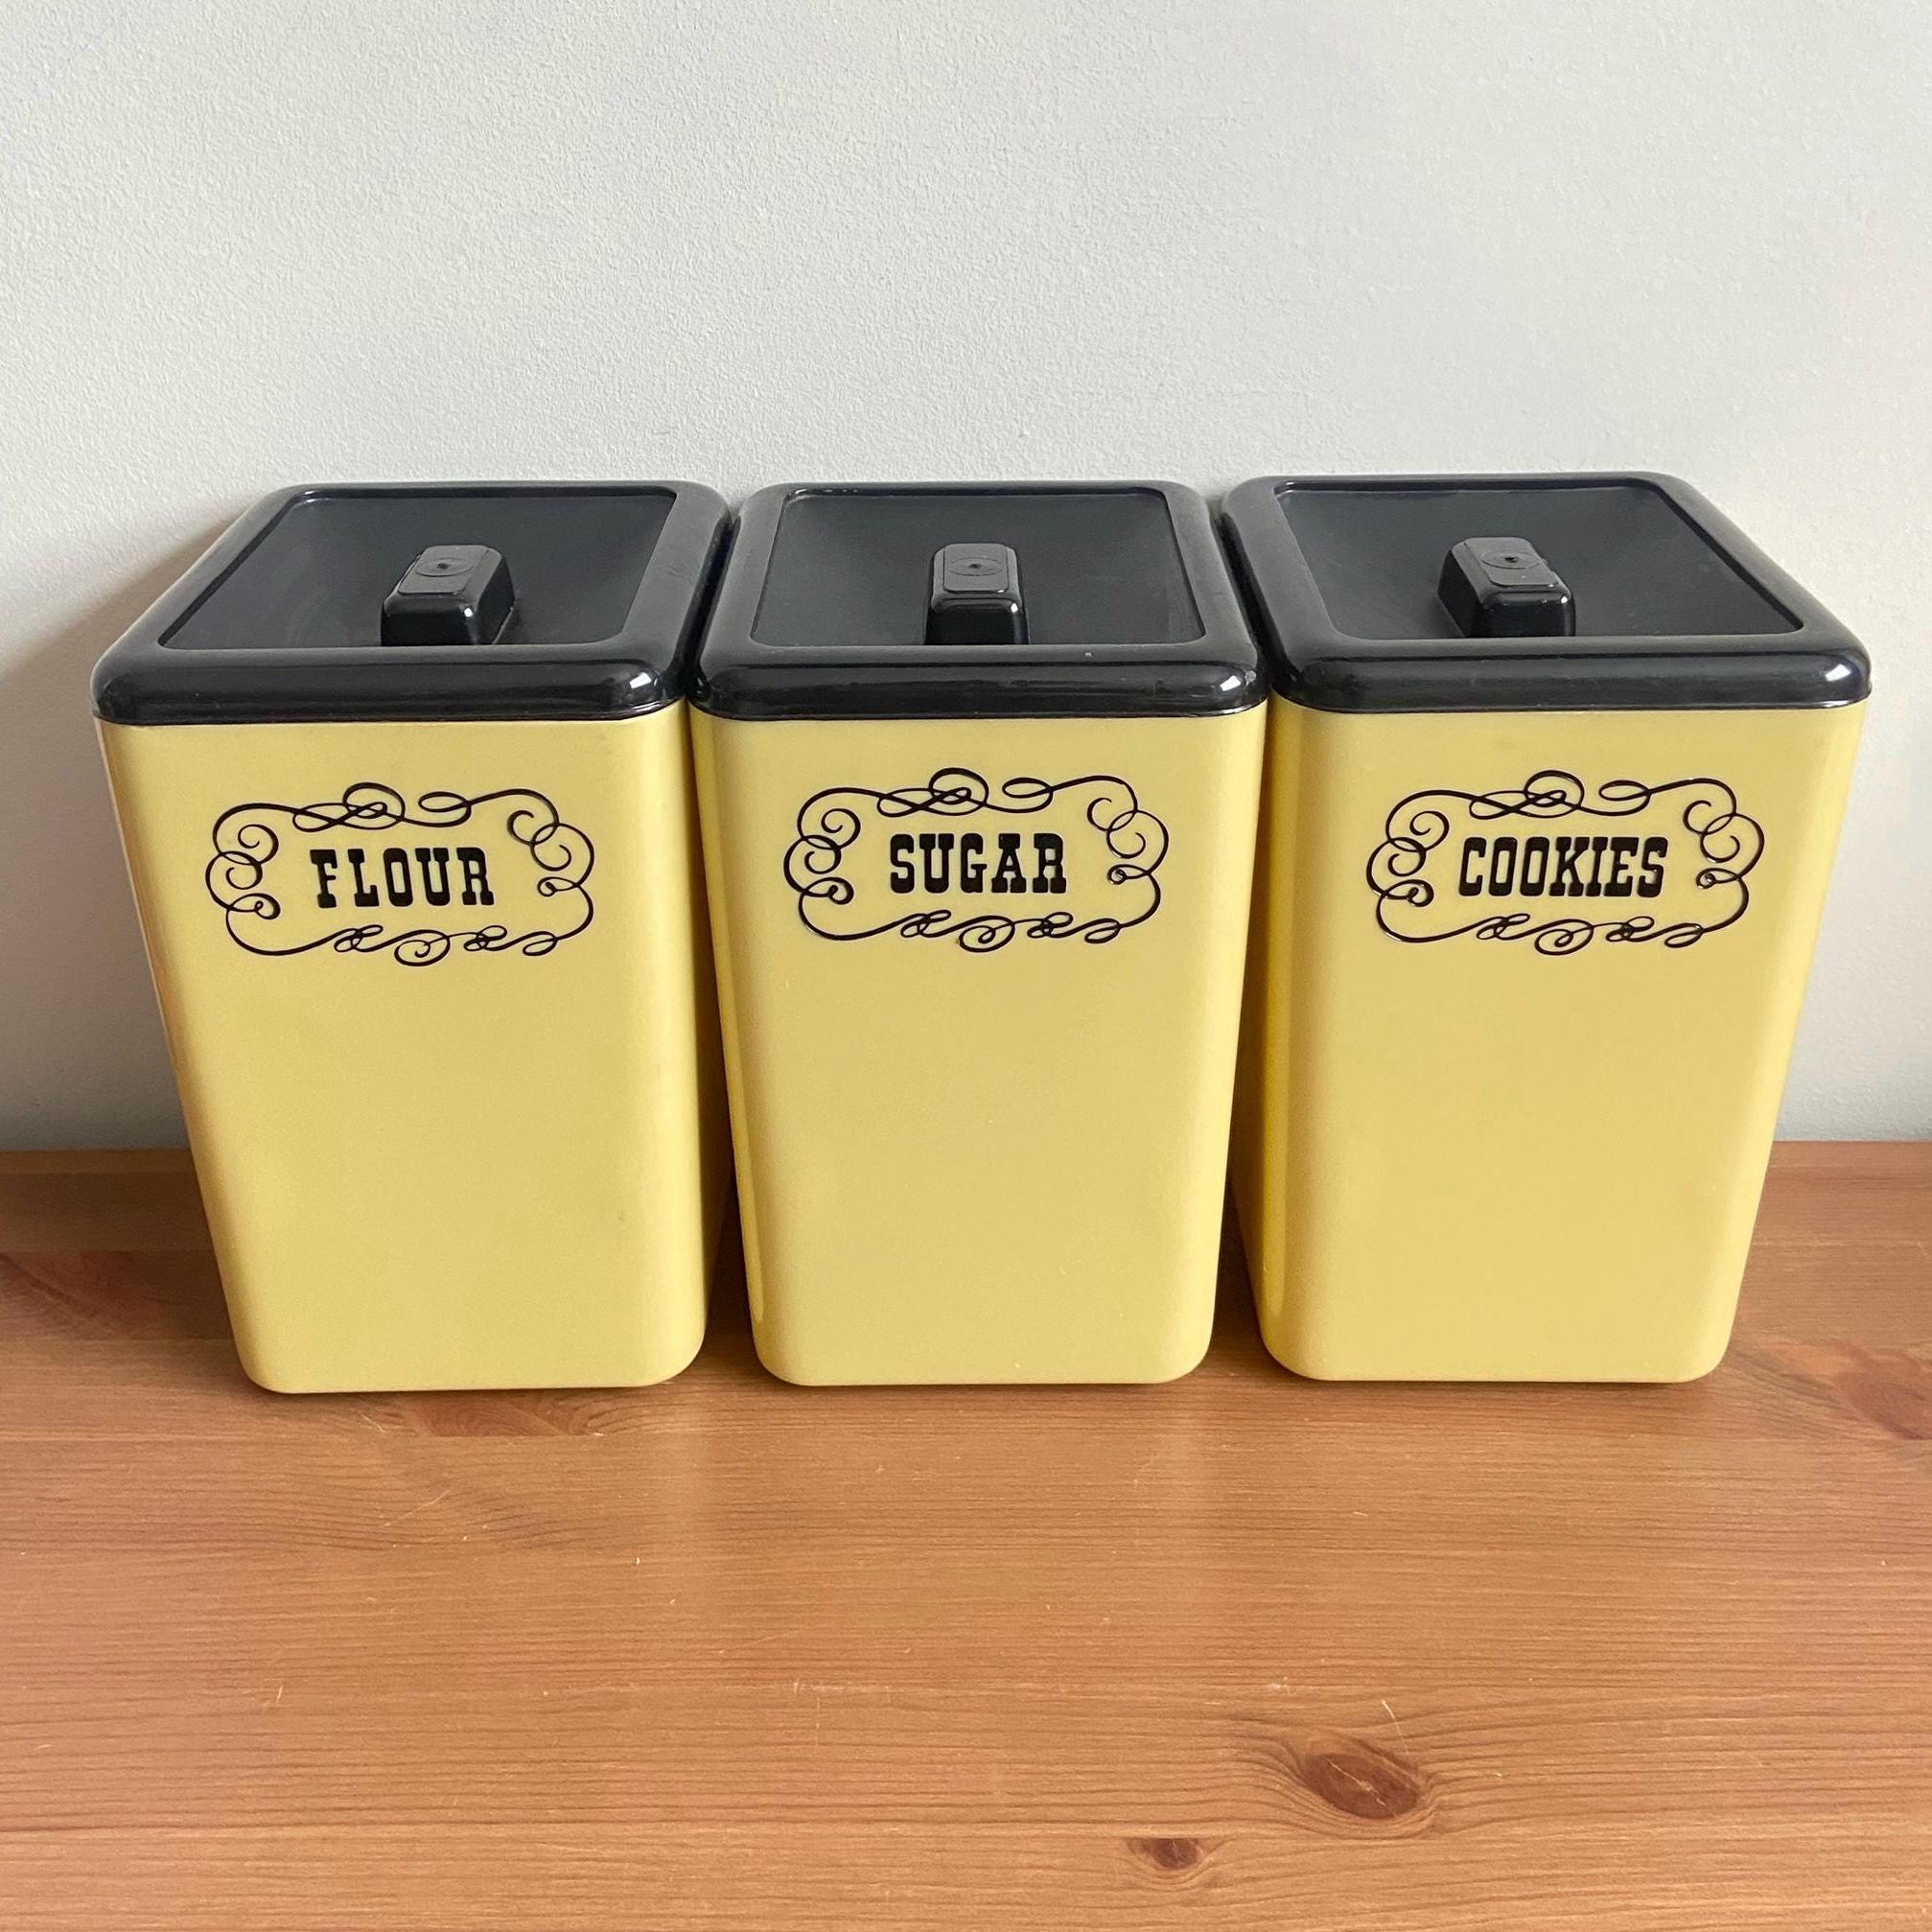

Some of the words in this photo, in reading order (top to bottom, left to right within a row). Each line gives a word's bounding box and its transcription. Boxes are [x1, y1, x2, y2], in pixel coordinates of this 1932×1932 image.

[310, 847, 495, 909] FLOUR
[889, 832, 1067, 895] SUGAR
[1458, 836, 1669, 898] COOKIES
